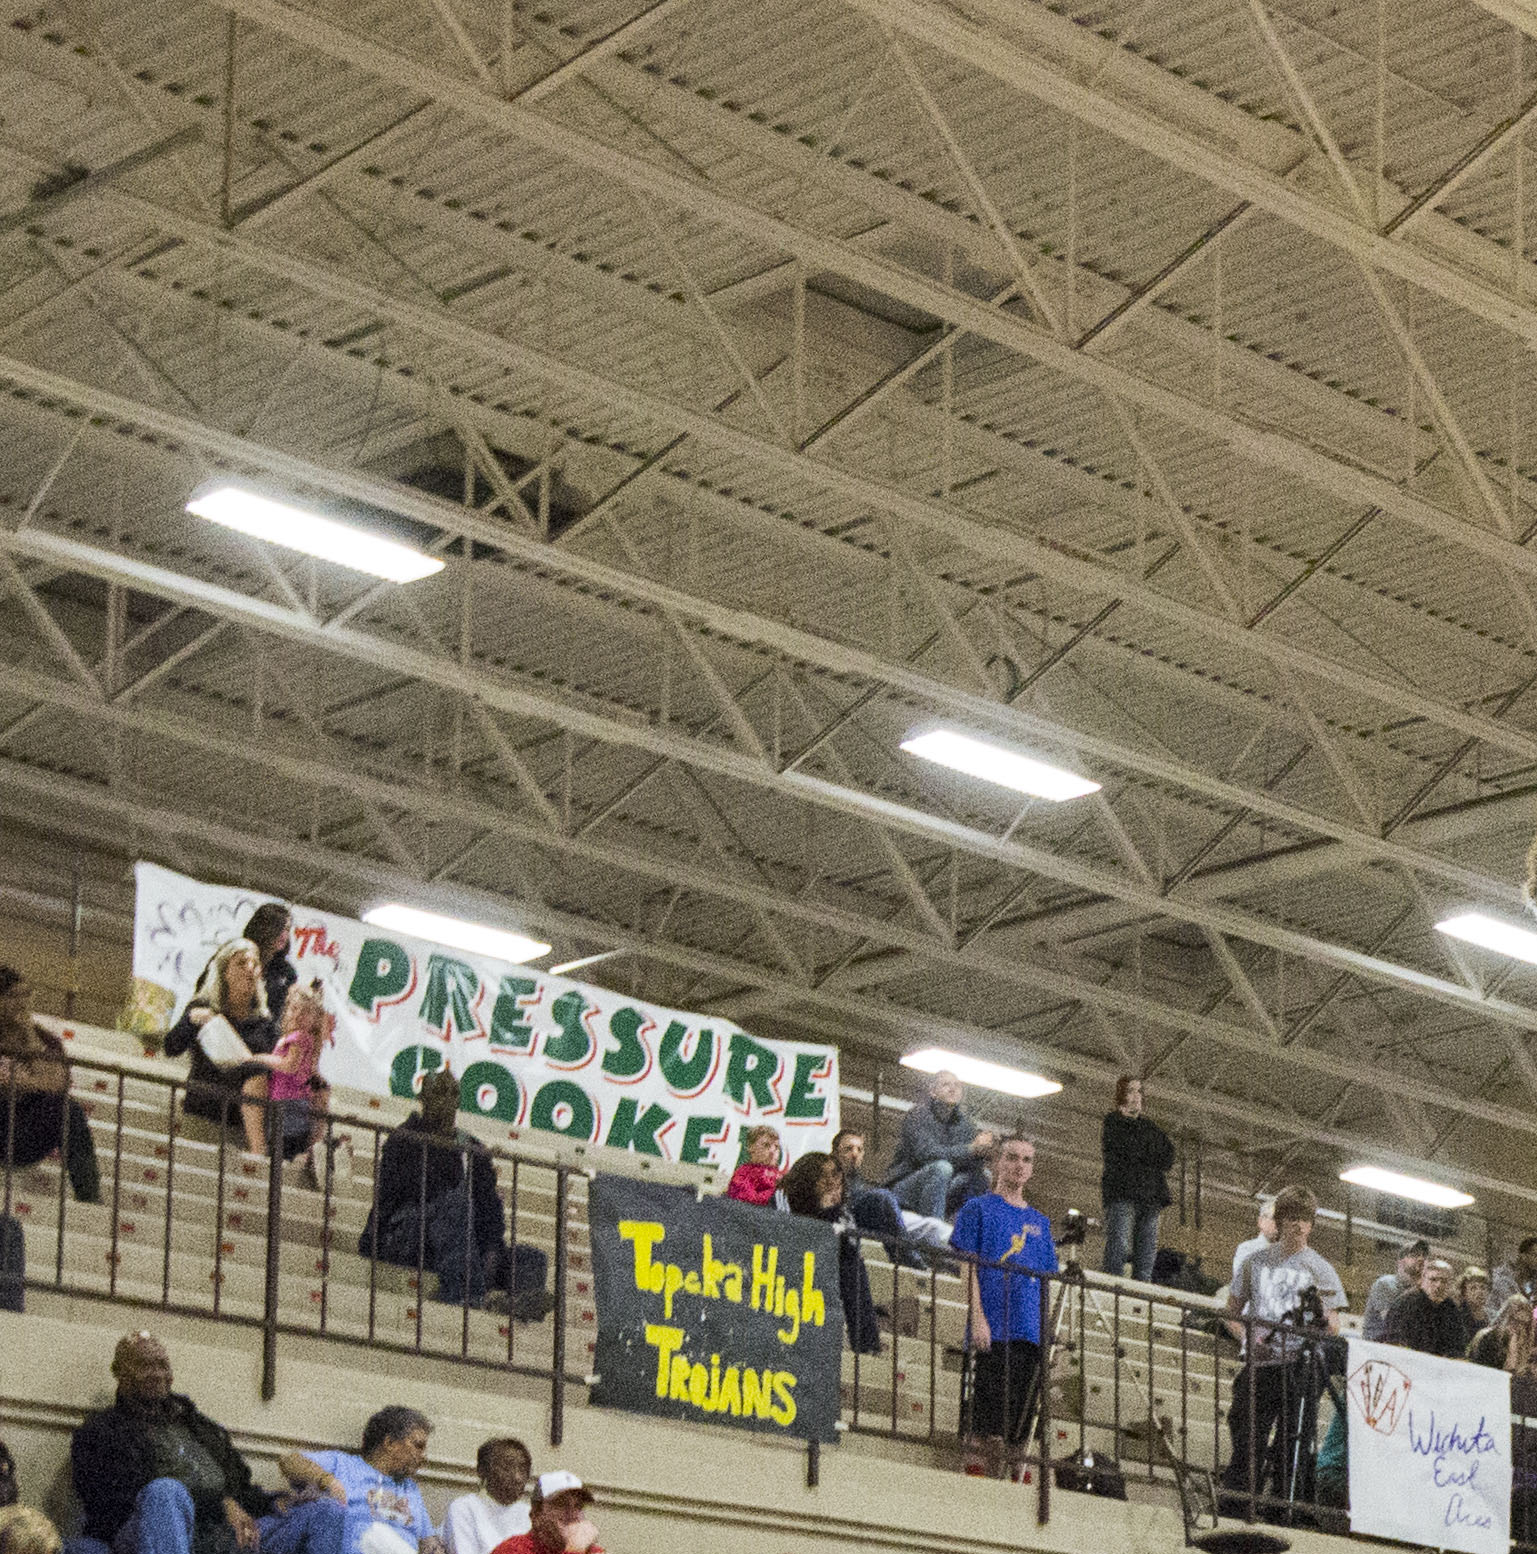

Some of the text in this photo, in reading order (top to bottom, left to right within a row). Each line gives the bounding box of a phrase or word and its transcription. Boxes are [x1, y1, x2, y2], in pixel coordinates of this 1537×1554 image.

[294, 925, 341, 960] The
[349, 938, 832, 1125] PRESSURE
[618, 1220, 825, 1344] Topeka High
[1408, 1410, 1501, 1456] Wichita
